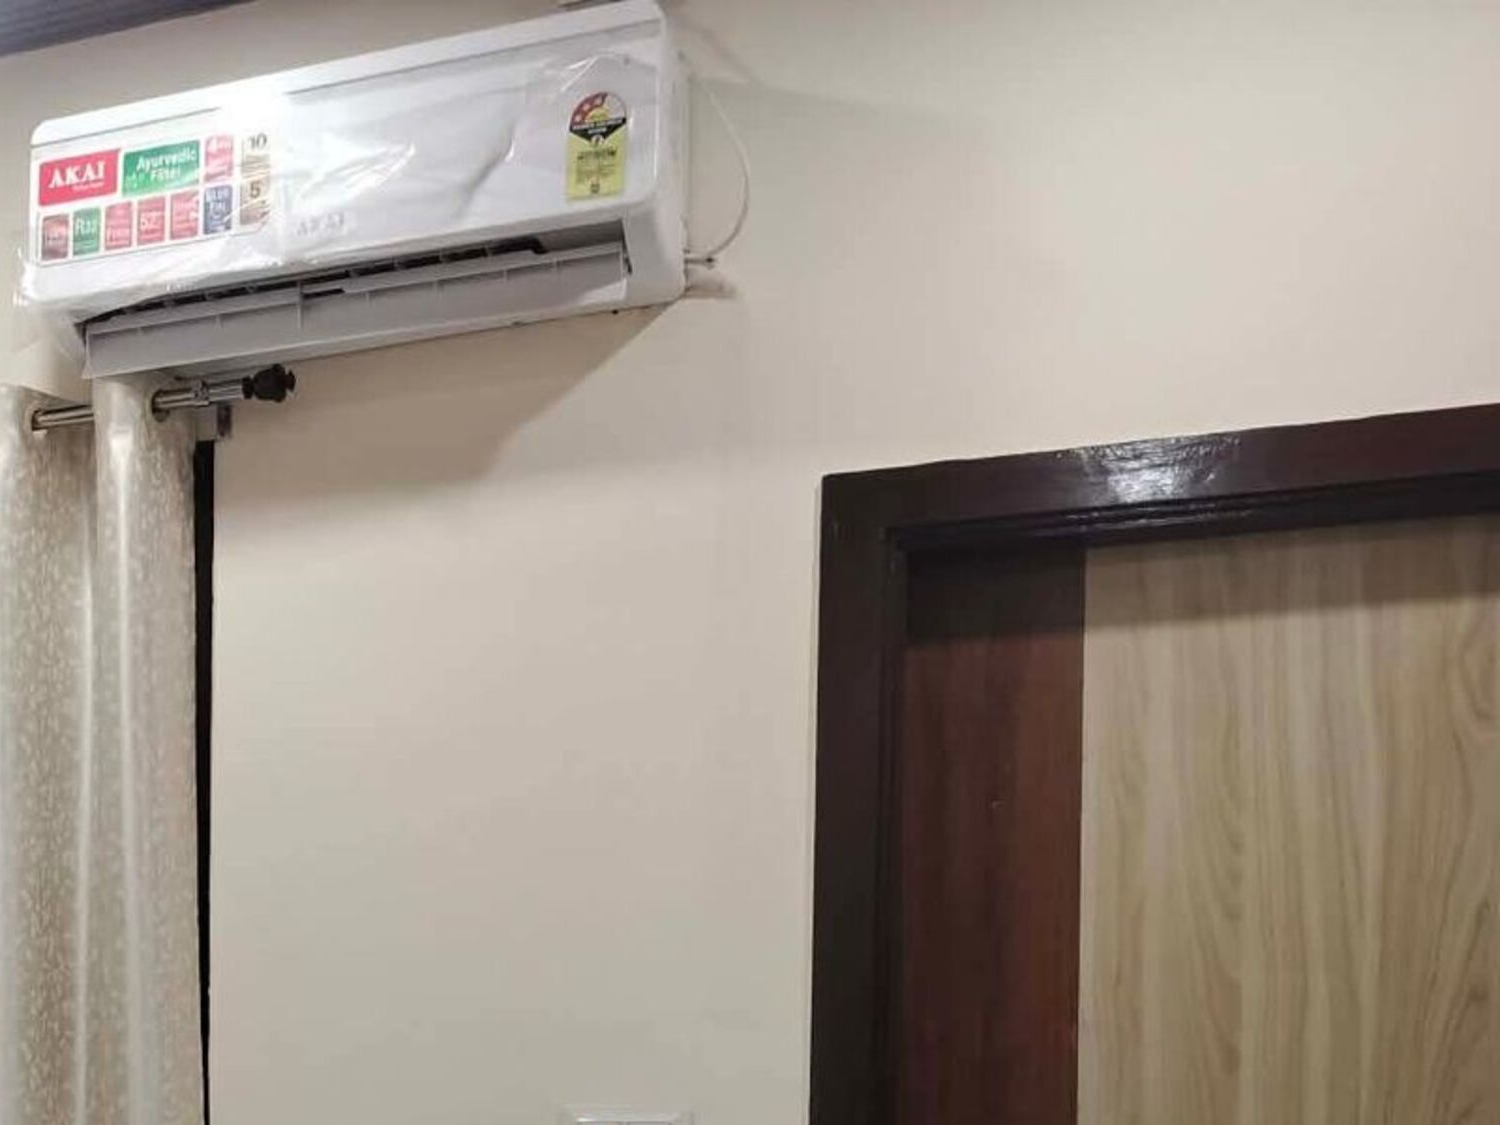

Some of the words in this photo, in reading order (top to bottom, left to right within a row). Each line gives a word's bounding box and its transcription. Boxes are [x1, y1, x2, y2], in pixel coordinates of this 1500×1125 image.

[247, 132, 268, 150] 10
[136, 147, 197, 173] Ayurvedic
[48, 160, 106, 189] AKAI
[249, 181, 262, 199] 5
